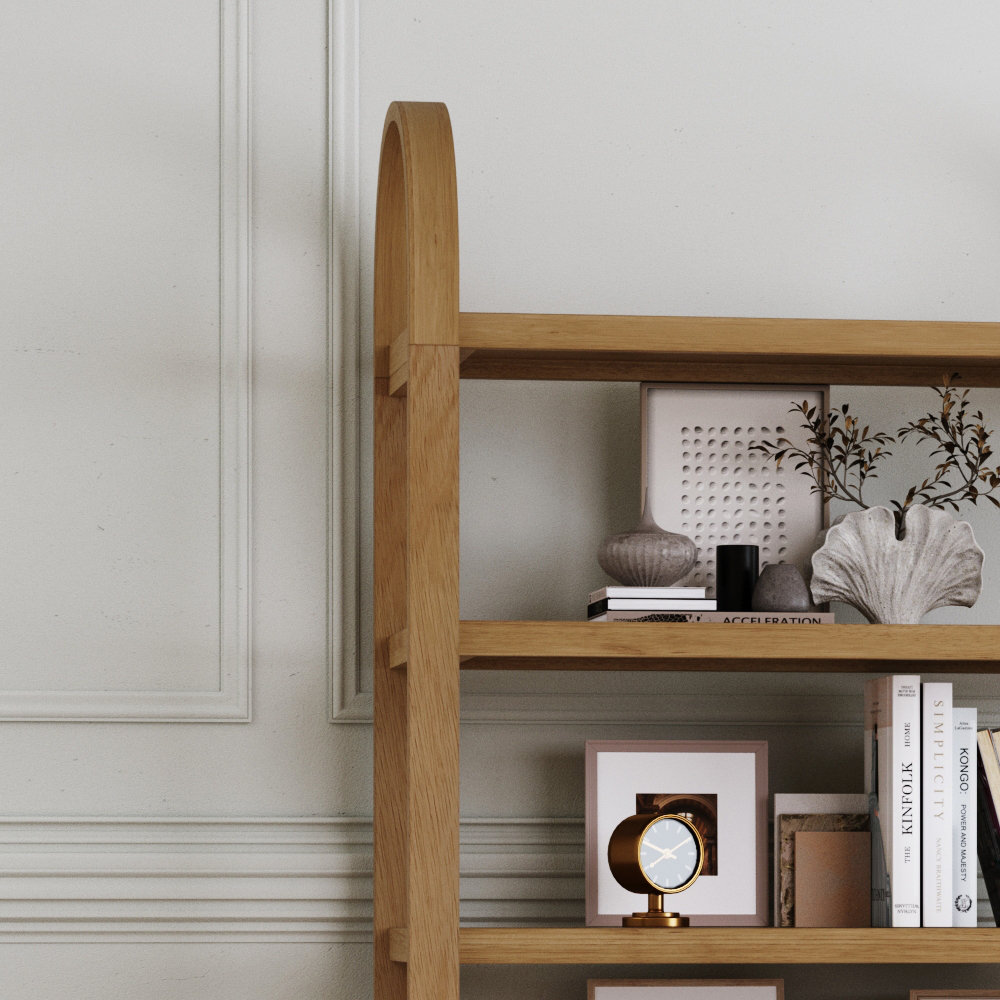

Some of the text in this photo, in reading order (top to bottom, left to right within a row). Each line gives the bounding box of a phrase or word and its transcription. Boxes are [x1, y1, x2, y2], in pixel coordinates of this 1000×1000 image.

[723, 616, 821, 624] ACCELERATION
[933, 700, 944, 821] SIMPLICITY
[960, 748, 969, 795] KONGO:
[901, 762, 913, 835] KINFOLK
